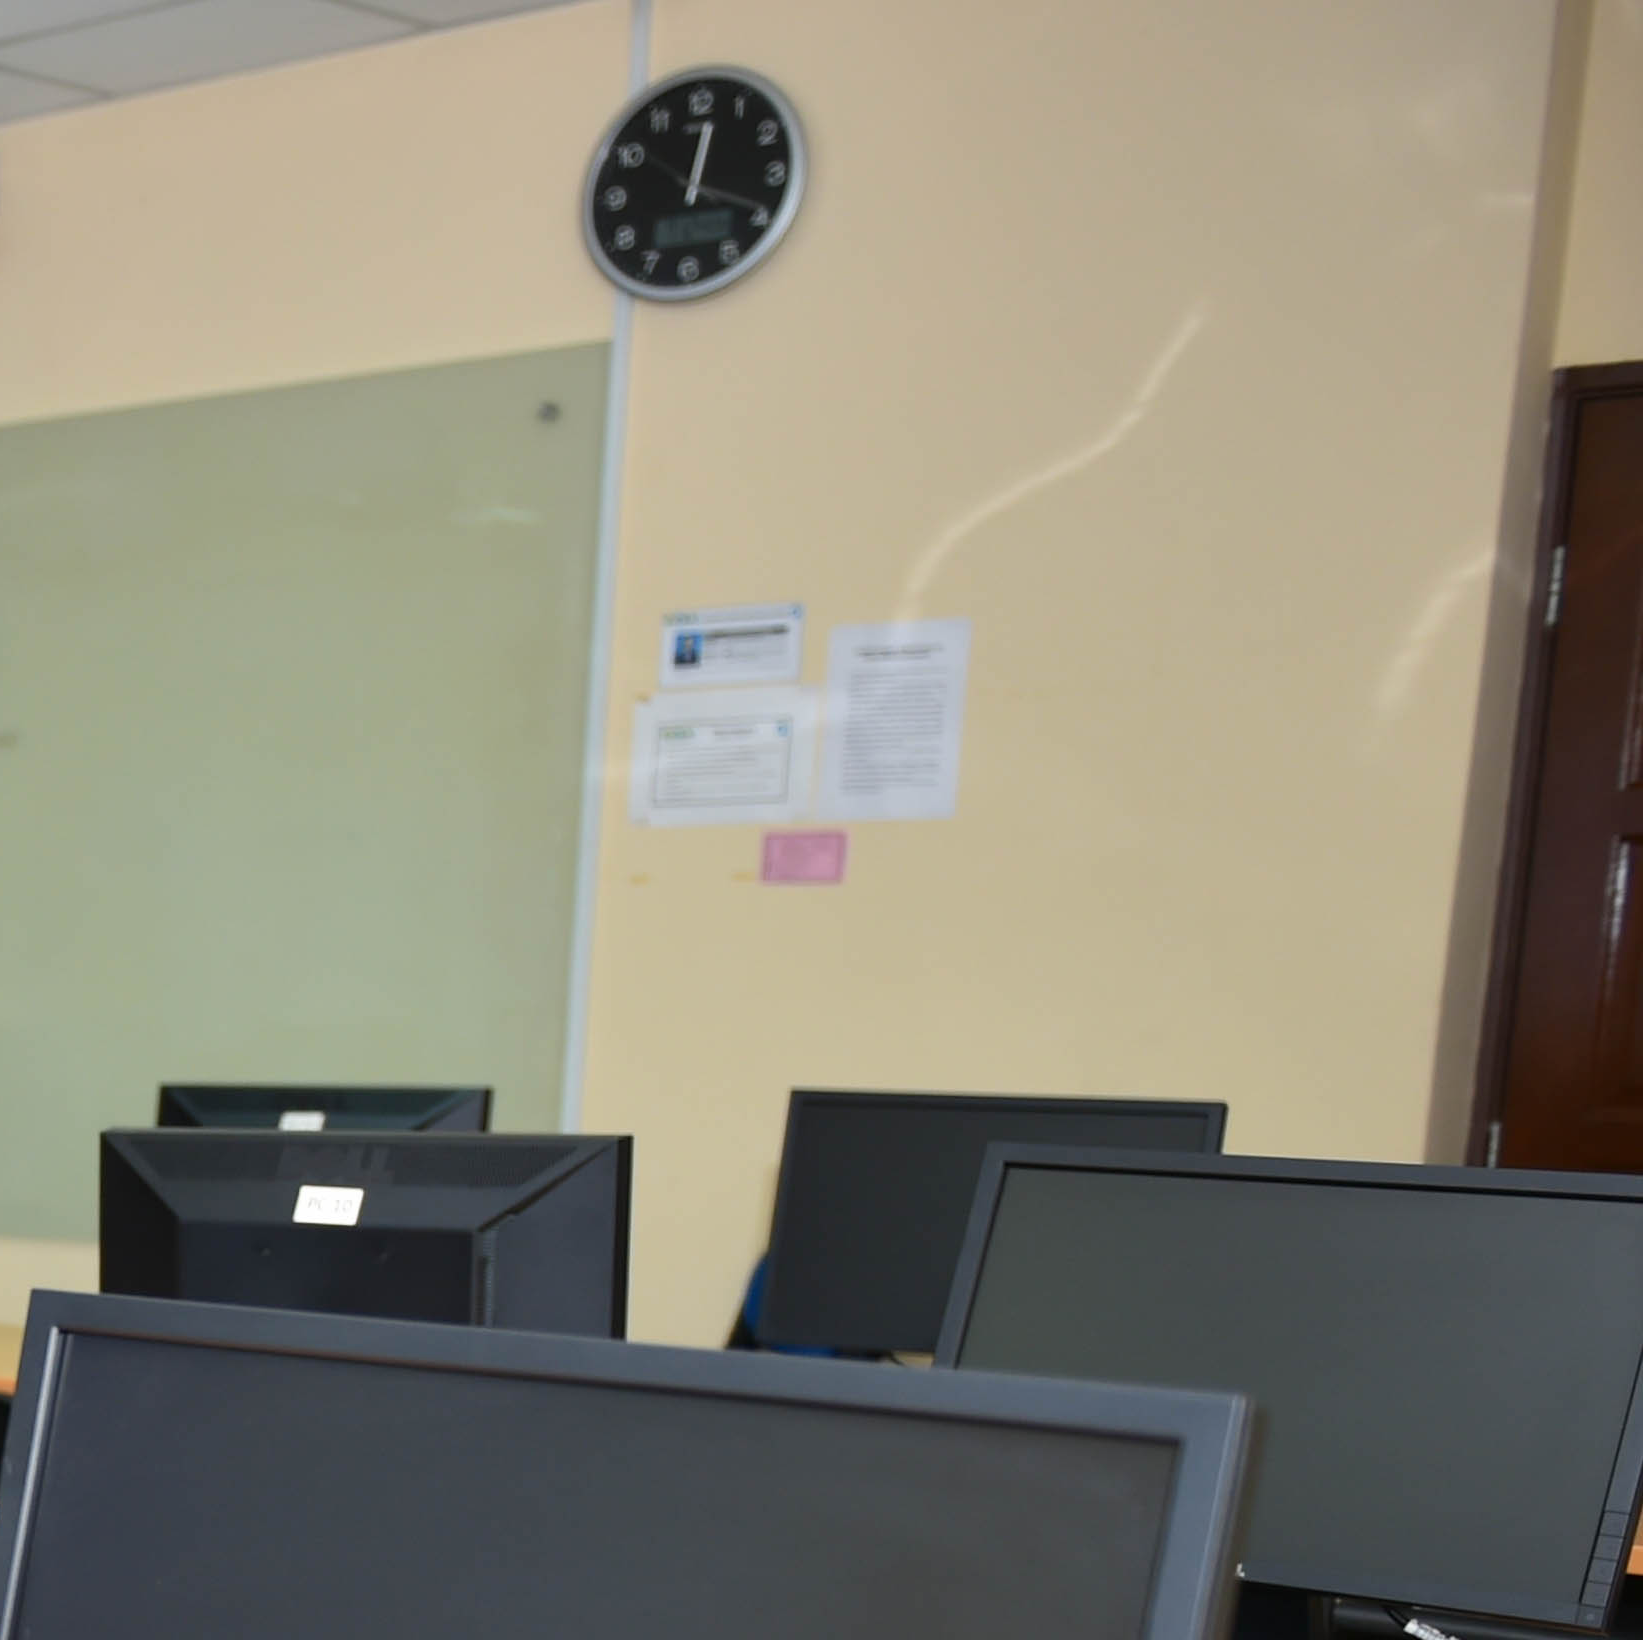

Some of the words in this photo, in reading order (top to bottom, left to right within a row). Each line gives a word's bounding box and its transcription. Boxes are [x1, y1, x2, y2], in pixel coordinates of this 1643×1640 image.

[688, 87, 714, 117] 12
[757, 119, 779, 146] 2
[618, 142, 645, 168] 10
[765, 160, 786, 187] 3
[604, 185, 627, 211] 9
[750, 207, 768, 227] 4
[614, 224, 635, 250] 8
[641, 250, 661, 274] 7
[677, 255, 700, 282] 6
